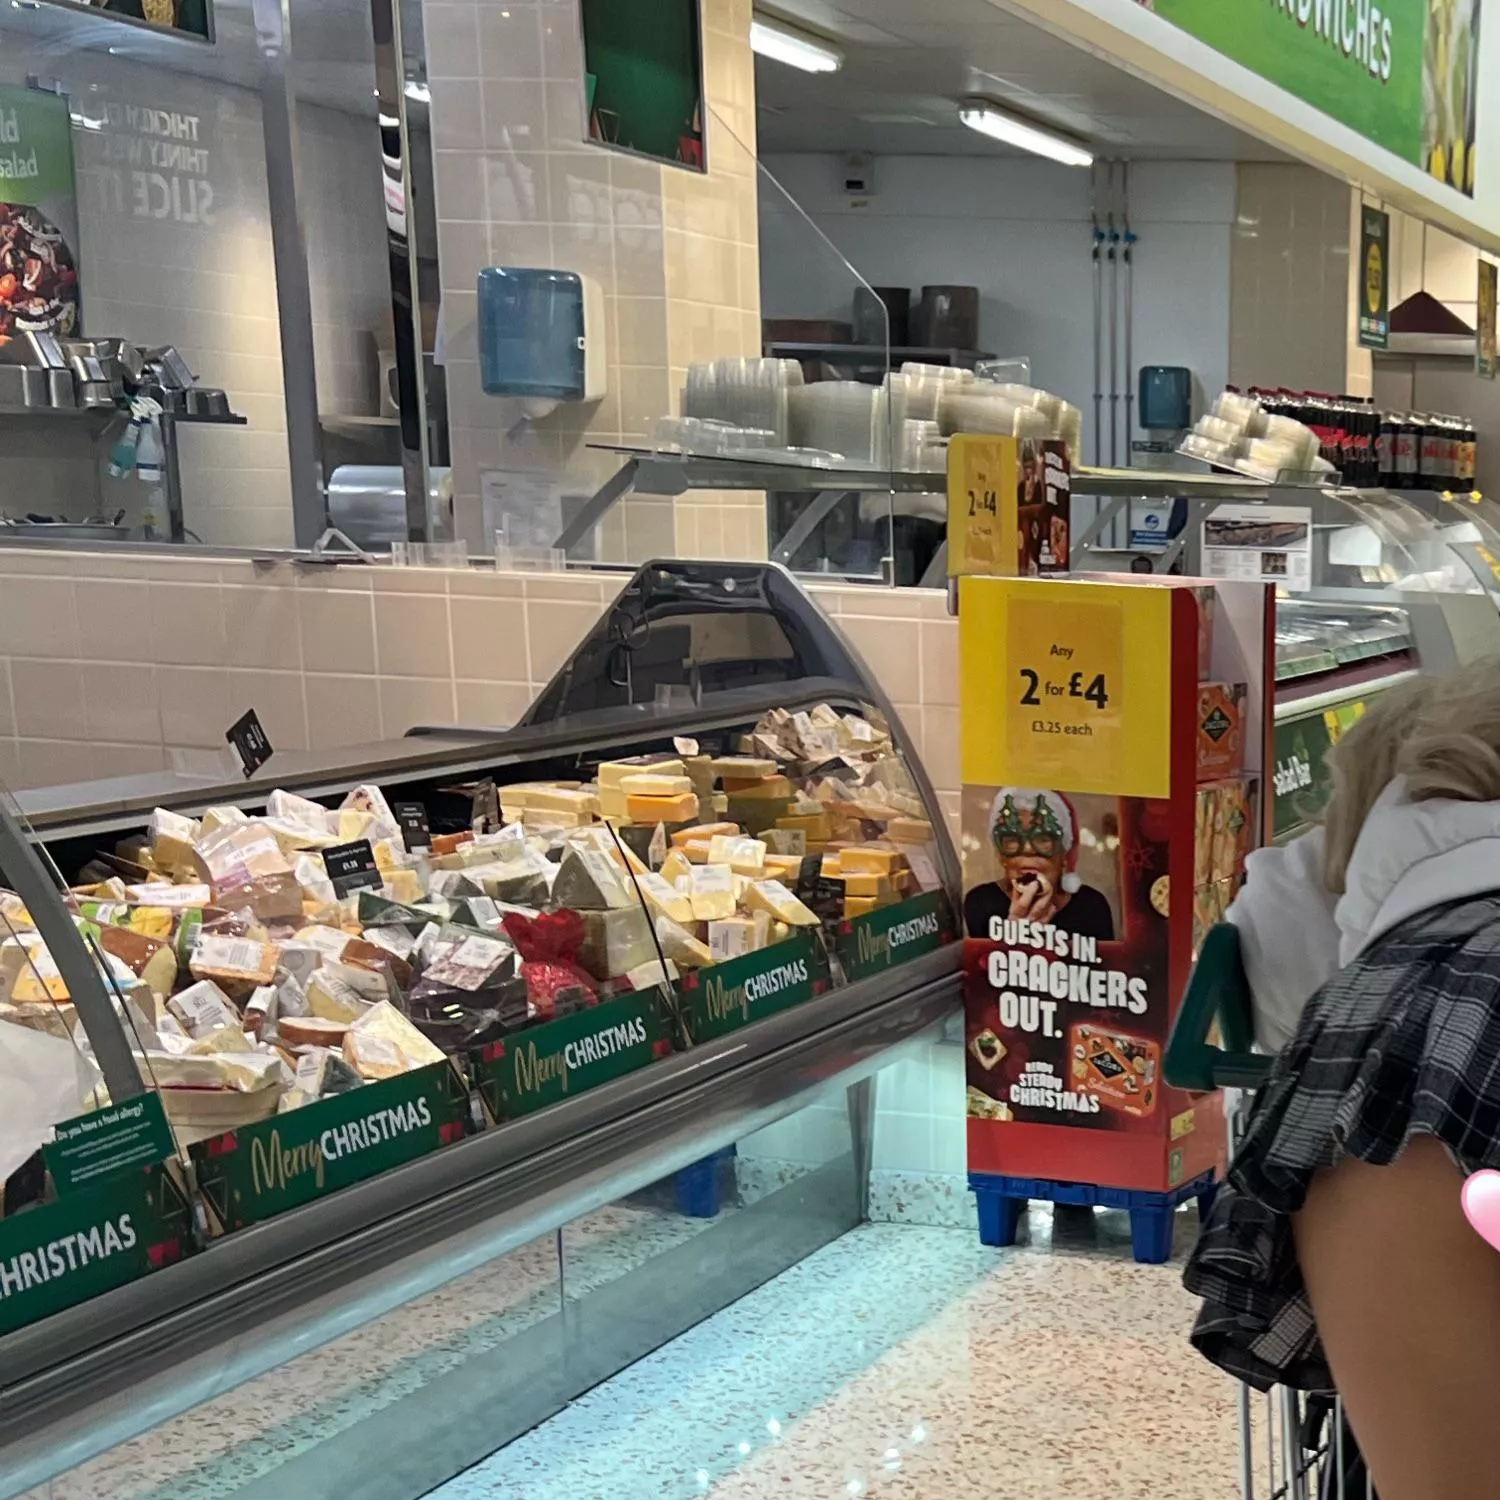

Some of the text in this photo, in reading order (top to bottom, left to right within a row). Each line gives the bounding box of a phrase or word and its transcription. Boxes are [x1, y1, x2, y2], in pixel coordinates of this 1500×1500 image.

[968, 490, 976, 516] 2
[1050, 644, 1073, 660] Any
[1020, 669, 1108, 709] 2 for £4
[1032, 721, 1092, 737] £3.25 each
[857, 912, 938, 964] Merry CHRISTMAS
[988, 915, 1102, 963] GUESTS IN.
[706, 958, 808, 1022] Merry CHRISTMAS
[988, 950, 1148, 1015] CRACKERS
[999, 991, 1063, 1039] OUT.
[514, 1016, 647, 1096] Merry CHRISTMAS
[68, 1127, 82, 1140] you
[81, 1121, 98, 1132] have
[102, 1111, 120, 1124] food
[119, 1102, 144, 1119] allergy?
[1010, 1084, 1101, 1114] CHRISTMAS
[251, 1096, 432, 1195] Merry CHRISTMAS
